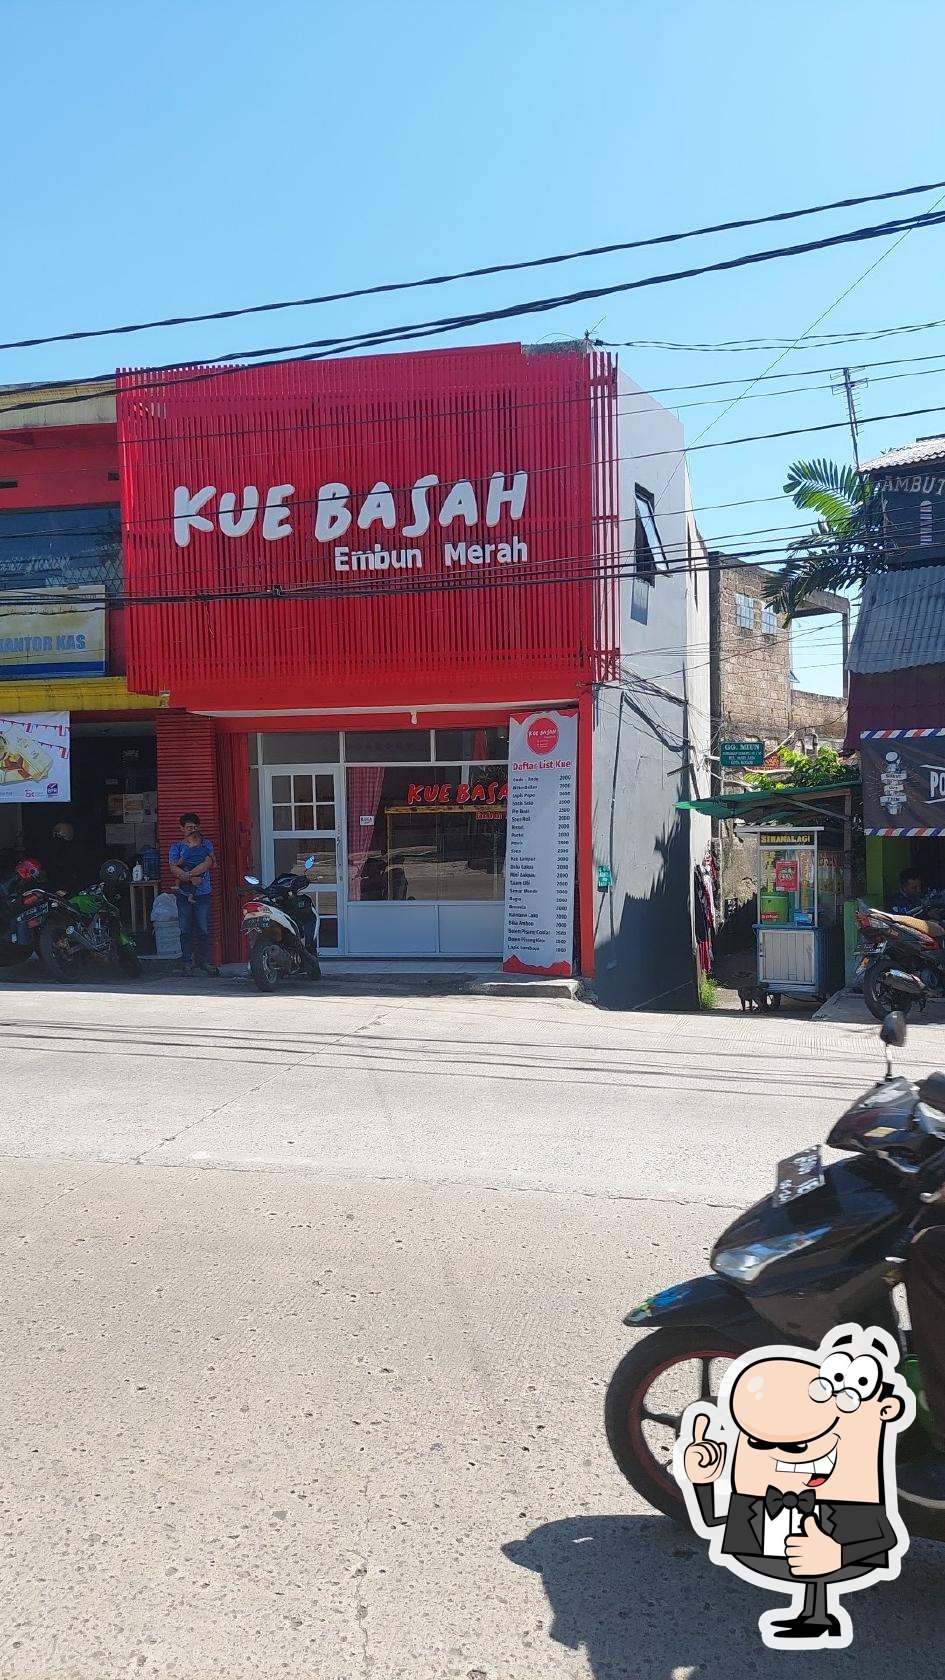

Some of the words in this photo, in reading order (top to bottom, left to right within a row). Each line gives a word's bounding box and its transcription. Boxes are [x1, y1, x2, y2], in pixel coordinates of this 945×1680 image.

[174, 483, 296, 548] KUE
[315, 470, 528, 543] BASAH
[335, 543, 423, 572] Embun
[444, 535, 528, 567] Merah
[56, 633, 86, 651] KAS
[512, 761, 537, 771] Daftar
[539, 760, 554, 769] List
[555, 759, 571, 768] Kue
[407, 783, 451, 805] KUE
